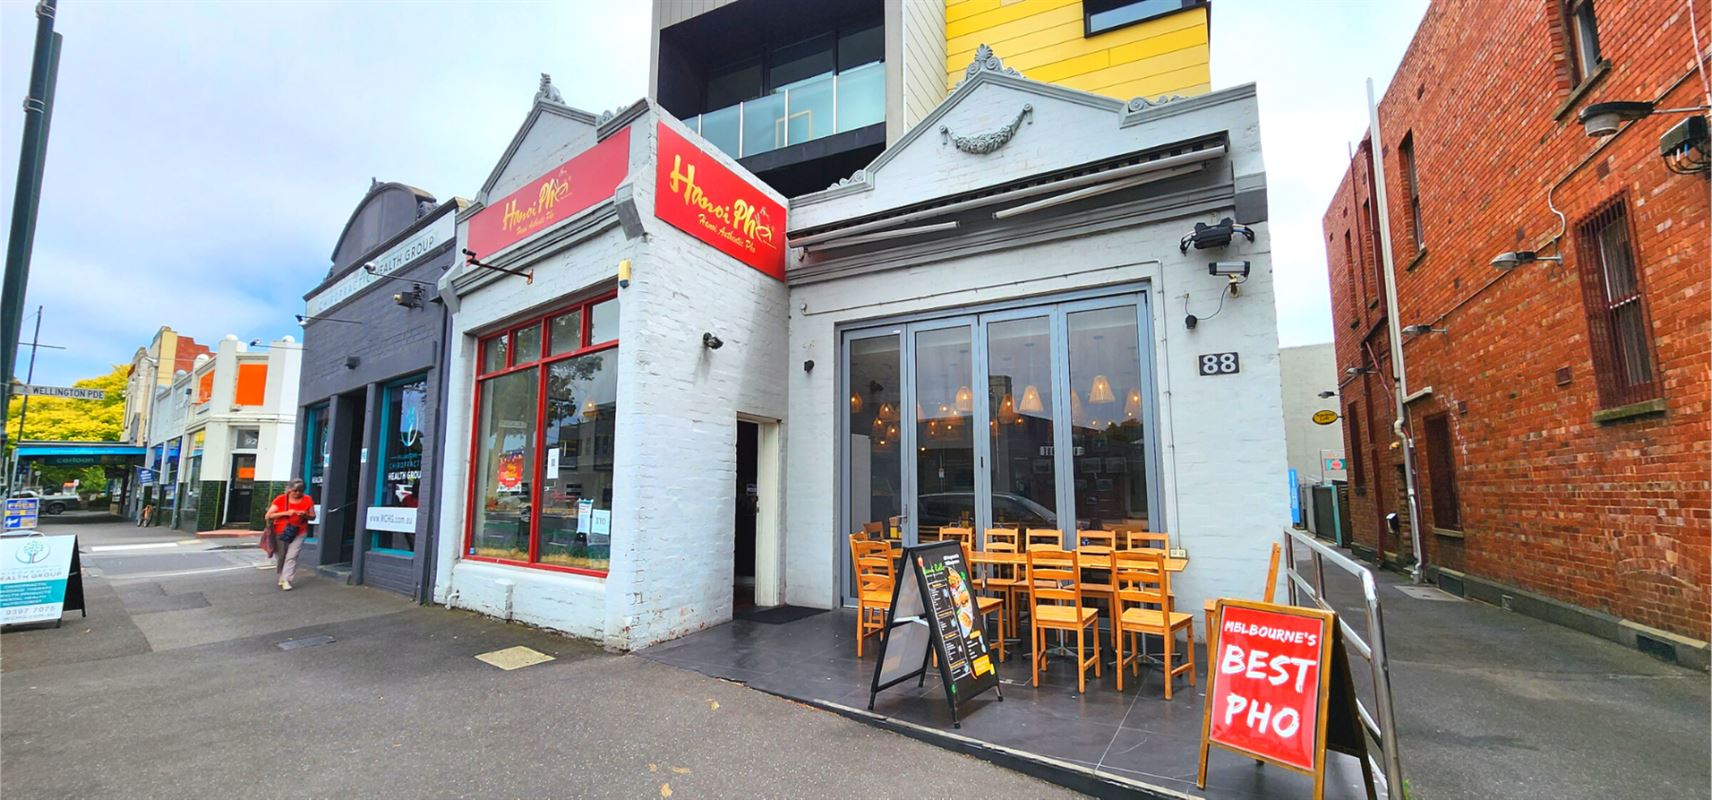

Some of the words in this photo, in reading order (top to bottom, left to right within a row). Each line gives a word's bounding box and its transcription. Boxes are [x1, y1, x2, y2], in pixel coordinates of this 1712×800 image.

[670, 154, 730, 225] Hanoi
[503, 198, 537, 231] Hanoi
[405, 236, 434, 261] GROUP
[1203, 353, 1236, 374] 88
[33, 386, 85, 398] WELLINGTON
[87, 390, 104, 399] PDE
[407, 470, 422, 480] GROU
[0, 573, 29, 581] EALTH
[1221, 645, 1317, 693] BEST
[1224, 692, 1300, 738] PHO
